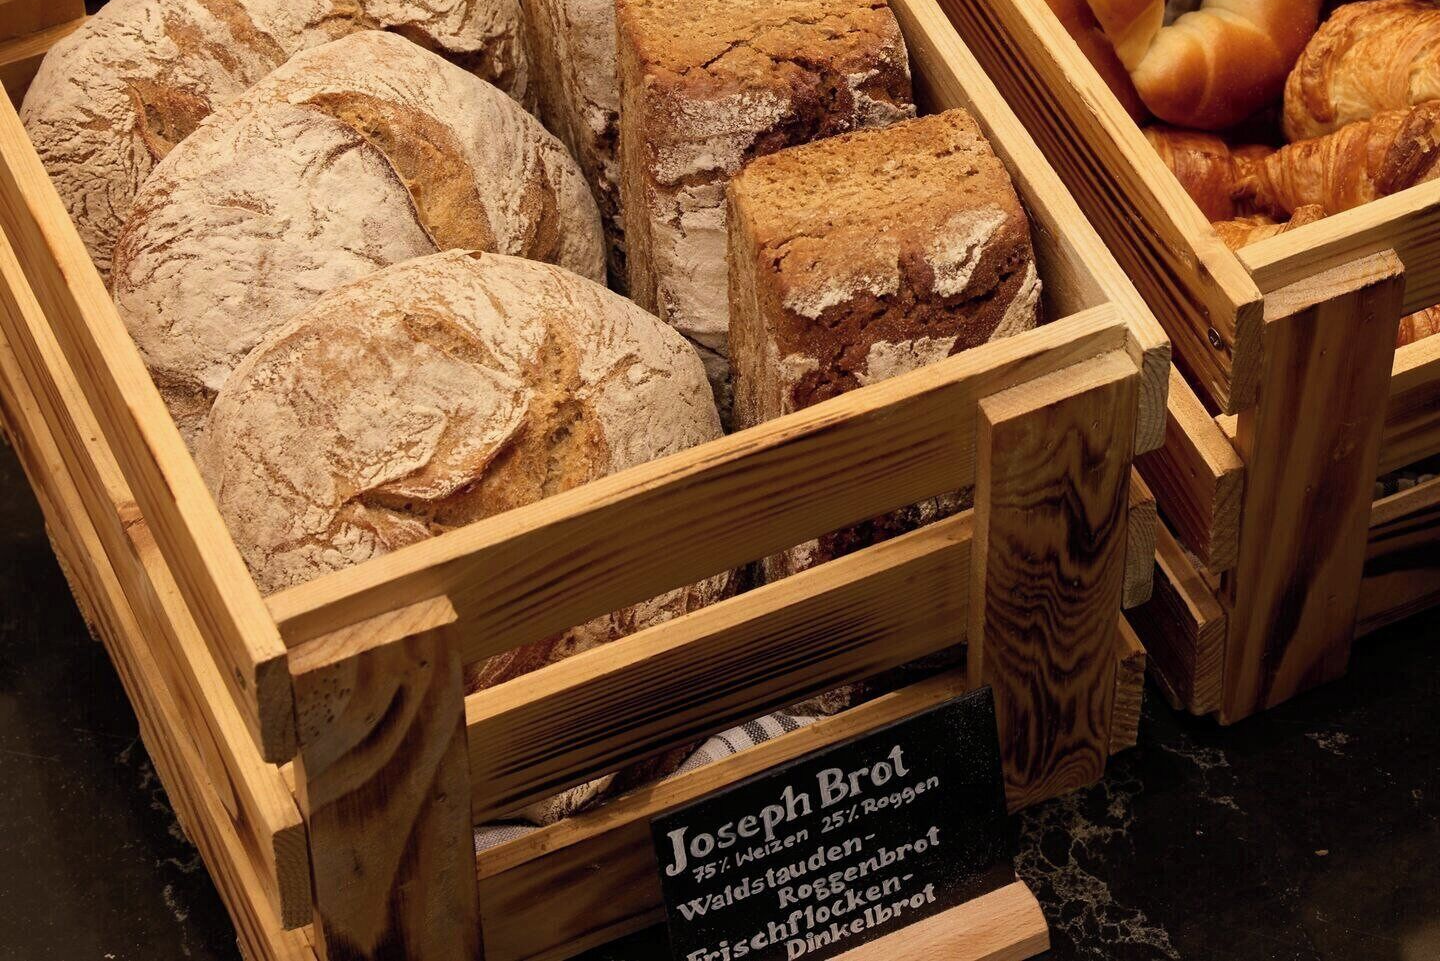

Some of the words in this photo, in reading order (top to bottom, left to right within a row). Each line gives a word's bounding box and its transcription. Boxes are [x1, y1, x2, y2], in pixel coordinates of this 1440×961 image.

[665, 785, 812, 877] Joseph
[817, 744, 909, 809] Brot
[736, 828, 809, 865] Weizen
[820, 807, 859, 834] 25%
[861, 775, 940, 813] Roggen
[677, 832, 876, 922] Waldstauden-
[778, 825, 941, 910] Roggenbrot
[783, 882, 937, 961] Dinkelbrot
